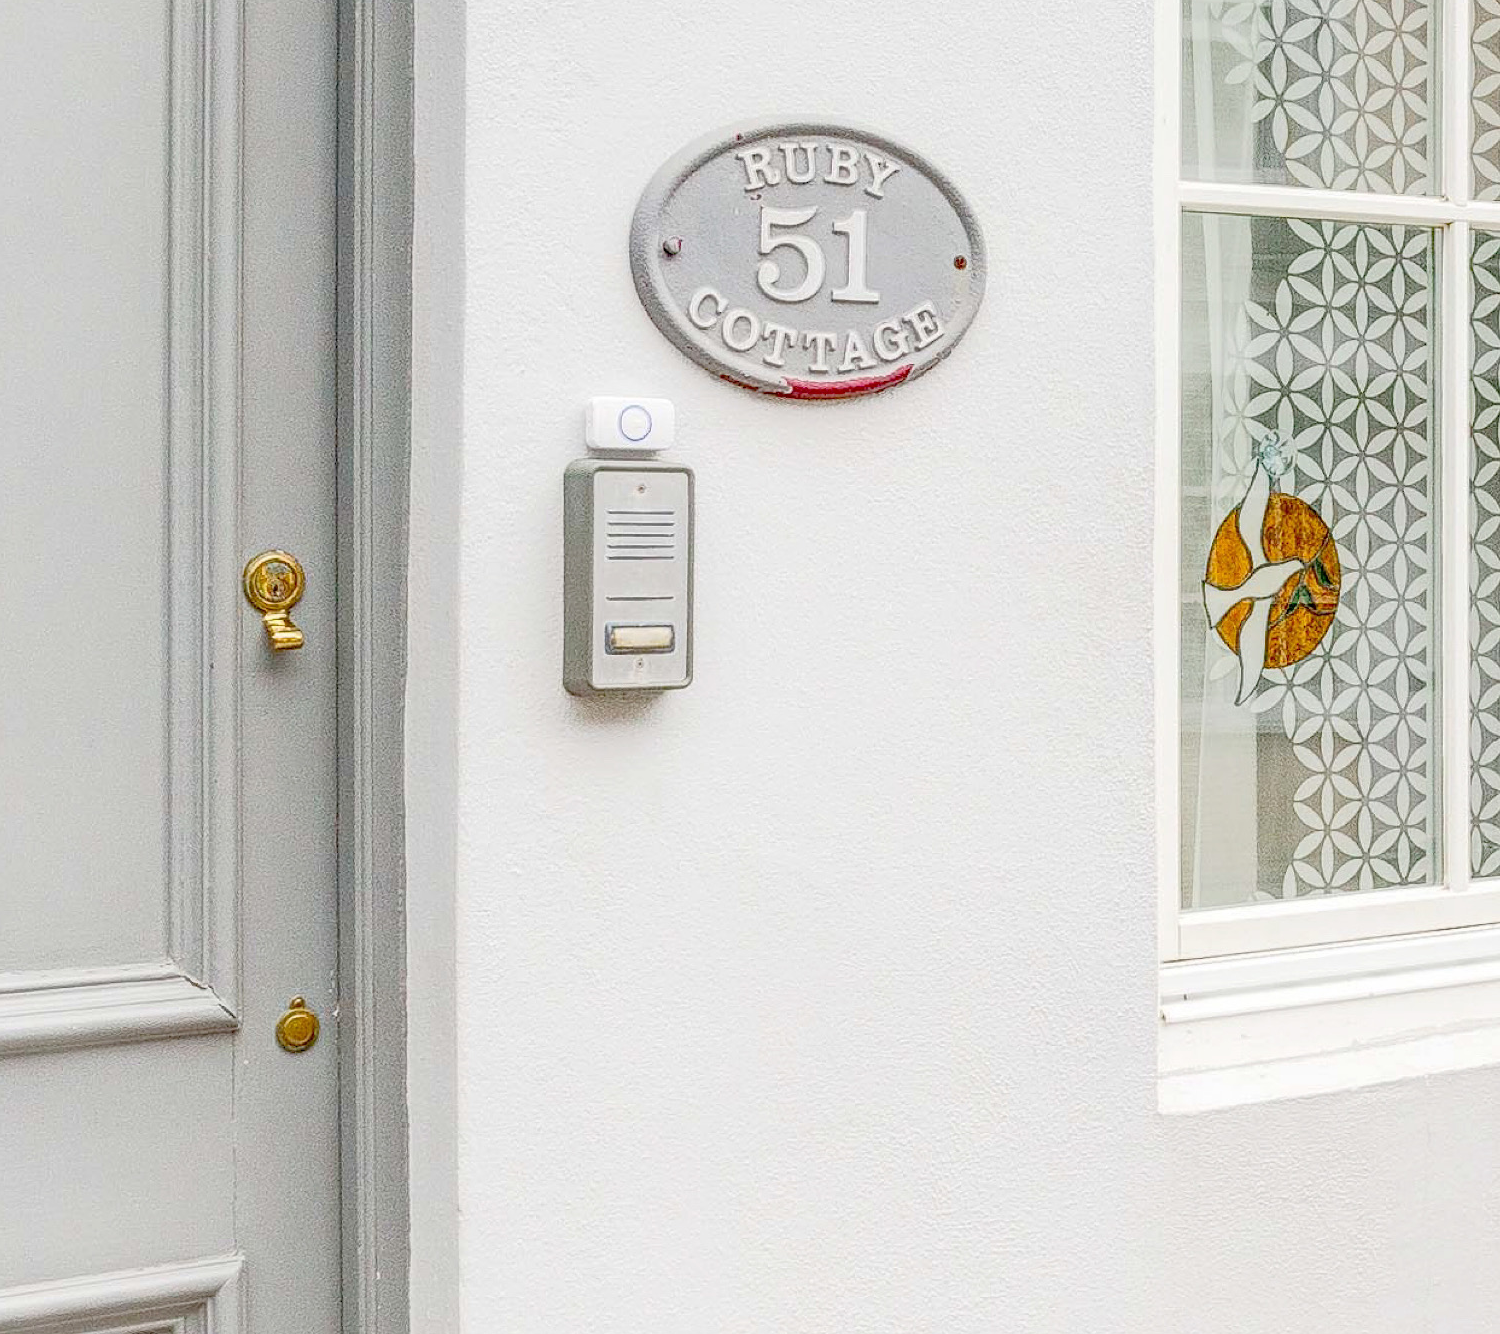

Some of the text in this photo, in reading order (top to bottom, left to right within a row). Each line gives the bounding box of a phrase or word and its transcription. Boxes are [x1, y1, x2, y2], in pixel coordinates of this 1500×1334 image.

[737, 141, 901, 201] RUBY
[756, 205, 881, 304] 51
[687, 287, 945, 375] COTTAGE
